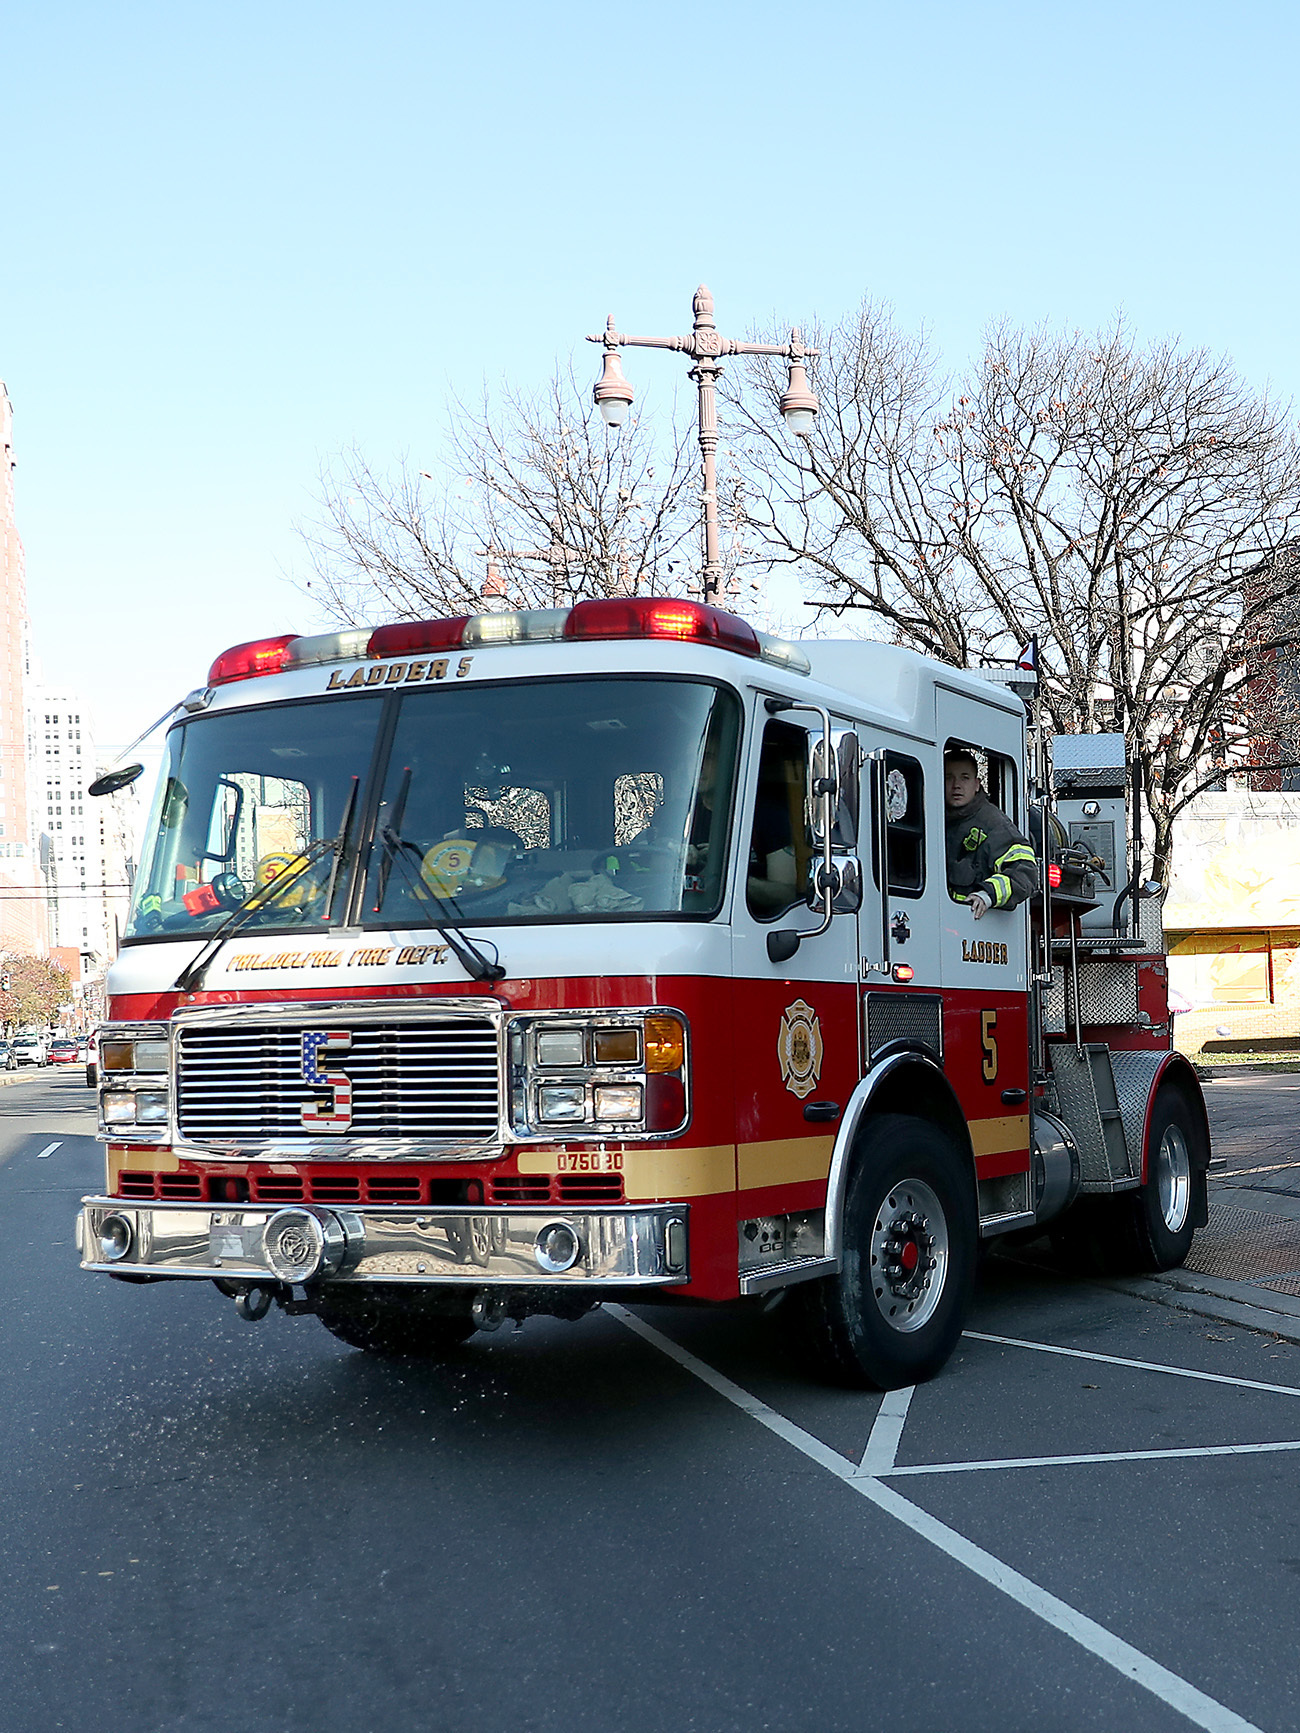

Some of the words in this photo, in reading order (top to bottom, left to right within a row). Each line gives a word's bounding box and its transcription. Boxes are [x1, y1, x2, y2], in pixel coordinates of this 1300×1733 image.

[326, 658, 450, 691] LADDER
[456, 656, 475, 679] 5
[264, 863, 279, 880] 5
[449, 852, 461, 868] 5
[226, 949, 346, 972] PHILADELPHIA
[348, 945, 397, 967] FIRE
[396, 944, 451, 966] DEPT.
[962, 938, 1009, 966] LADDER
[980, 1008, 998, 1086] 5
[300, 1029, 353, 1135] 5
